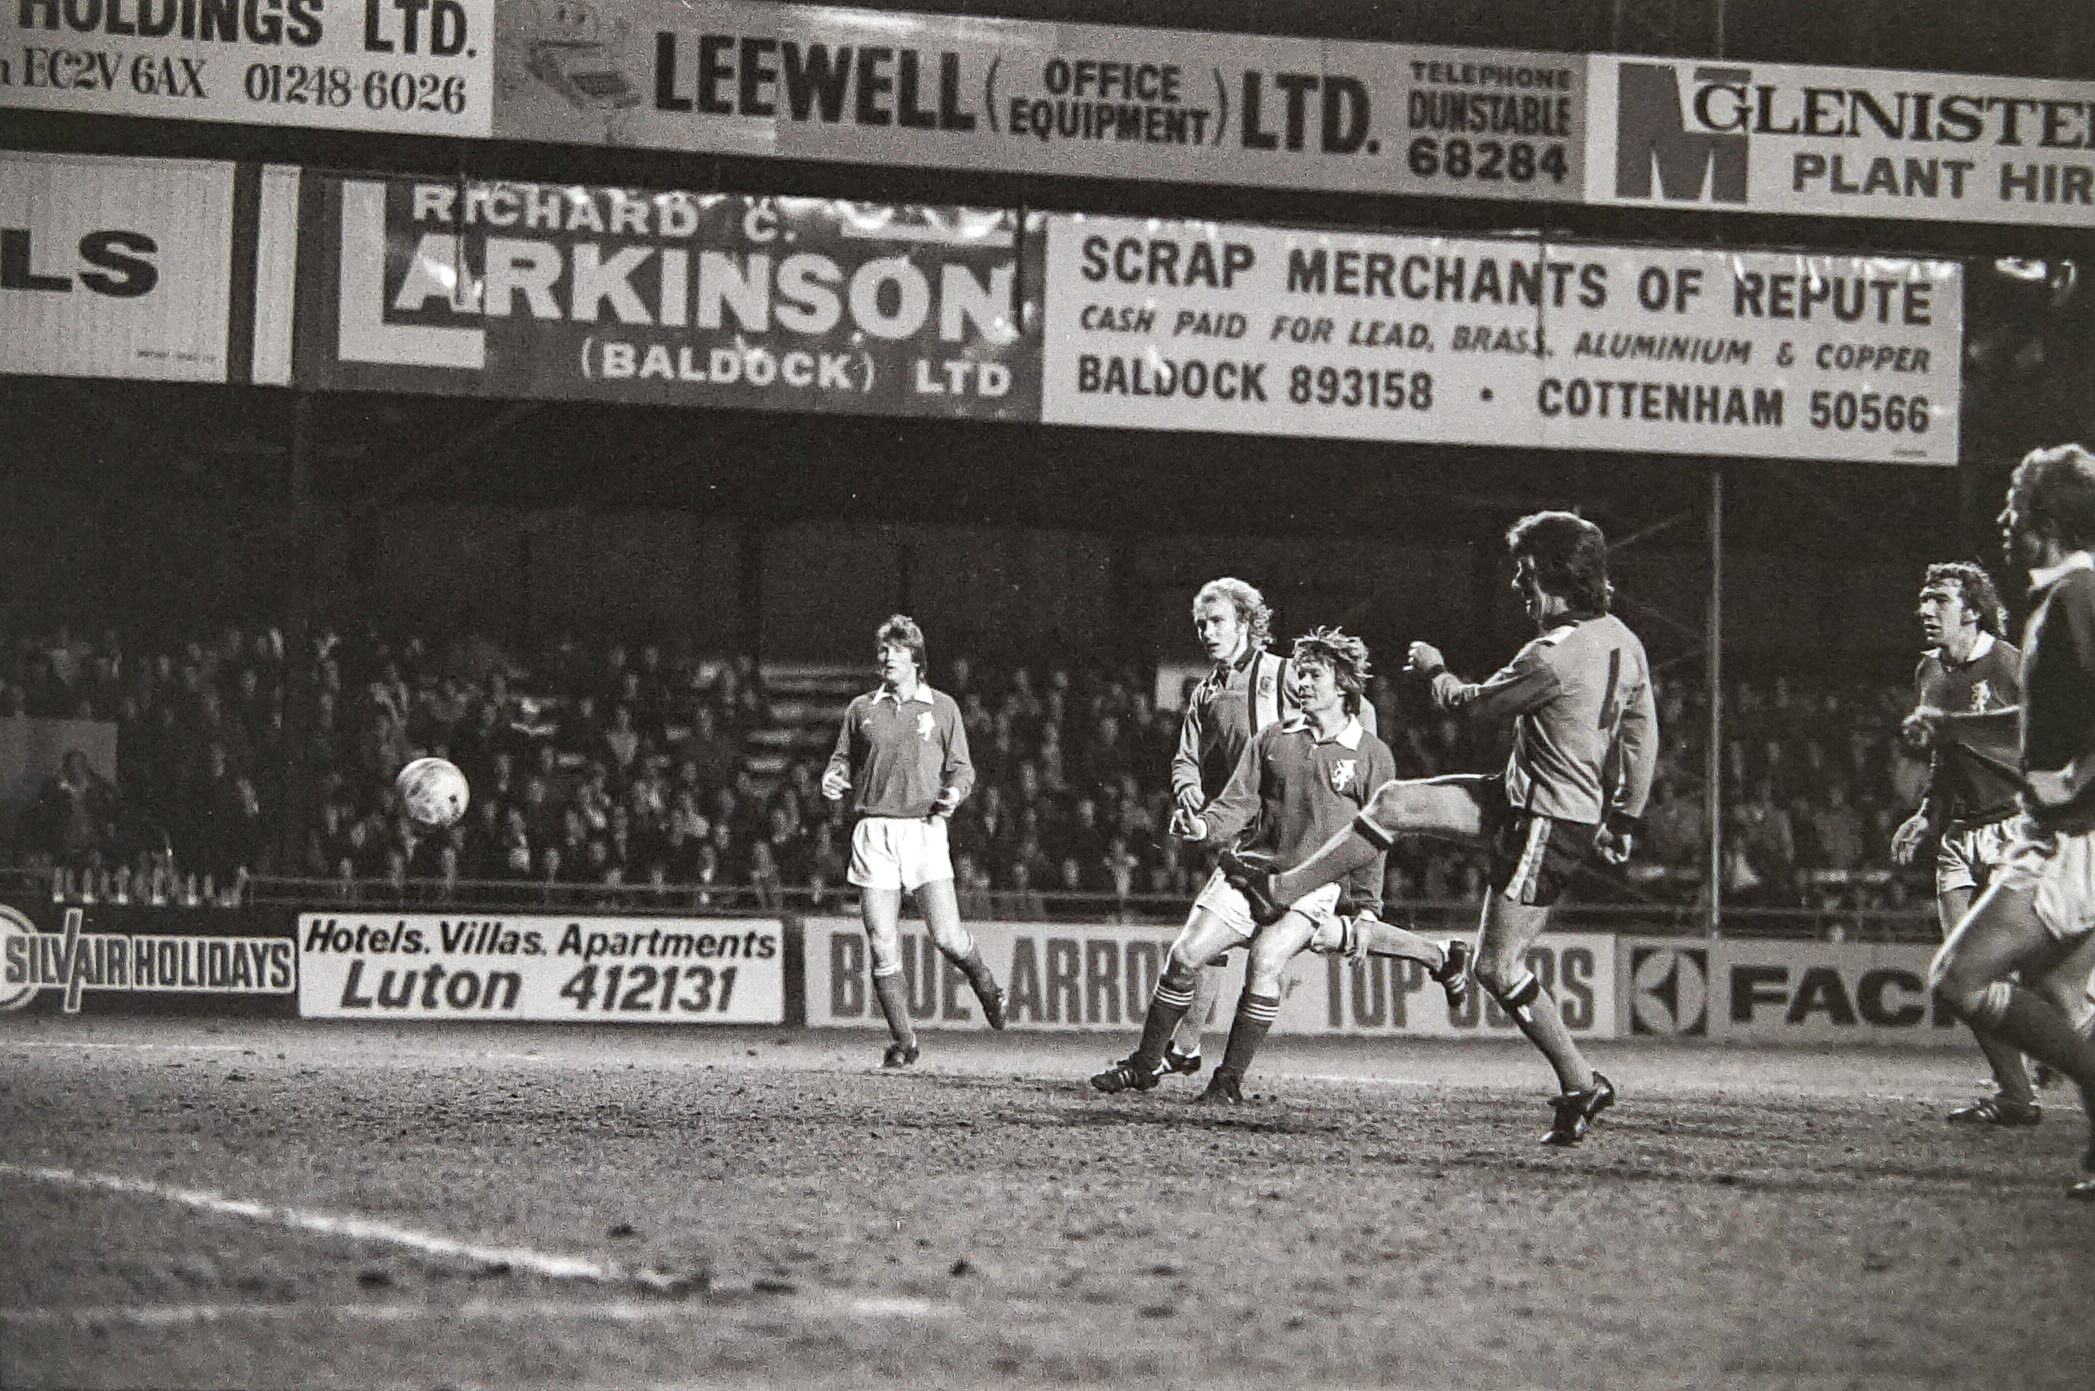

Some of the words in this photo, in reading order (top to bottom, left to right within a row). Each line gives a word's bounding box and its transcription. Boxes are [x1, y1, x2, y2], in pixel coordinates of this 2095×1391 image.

[364, 0, 477, 57] LTD.
[24, 48, 121, 90] EC2V
[132, 55, 207, 98] 6AX
[656, 31, 976, 132] LEEWELL
[1044, 58, 1180, 102] OFFICE
[1410, 60, 1572, 88] TELEPHONE
[1009, 97, 1210, 146] EQUIPMENT
[1241, 70, 1380, 154] LTD.
[1407, 88, 1571, 136] DUNSTABLE
[1694, 83, 2095, 149] GLENISTE
[1408, 136, 1568, 184] 68284
[1792, 152, 1975, 199] PLANT
[413, 183, 699, 237] RICHARD
[743, 197, 797, 242] C.
[1081, 234, 1256, 288] SCRAP
[1287, 248, 1609, 309] MERCHANTS
[1636, 266, 1704, 314] OF
[1734, 270, 1933, 326] REPUTE
[1080, 305, 1156, 334] CASH
[1173, 309, 1248, 339] PAID
[1269, 314, 1335, 345] FOR
[1575, 331, 1753, 366] ALUMINIUM
[1776, 341, 1796, 369] &
[1816, 343, 1932, 375] COPPER
[915, 358, 1012, 397] LTD
[1078, 354, 1269, 402] BALDOCK
[1288, 363, 1433, 411] 893158
[1537, 376, 1784, 427] COTTENHAM
[1810, 390, 1931, 434] 50566
[134, 939, 292, 990] HOLIDAYS
[557, 923, 777, 963] Apartments
[340, 958, 523, 1010] Luton
[559, 963, 738, 1013] 412131
[830, 932, 975, 1020] BUE
[1008, 938, 1176, 1025] ARRO
